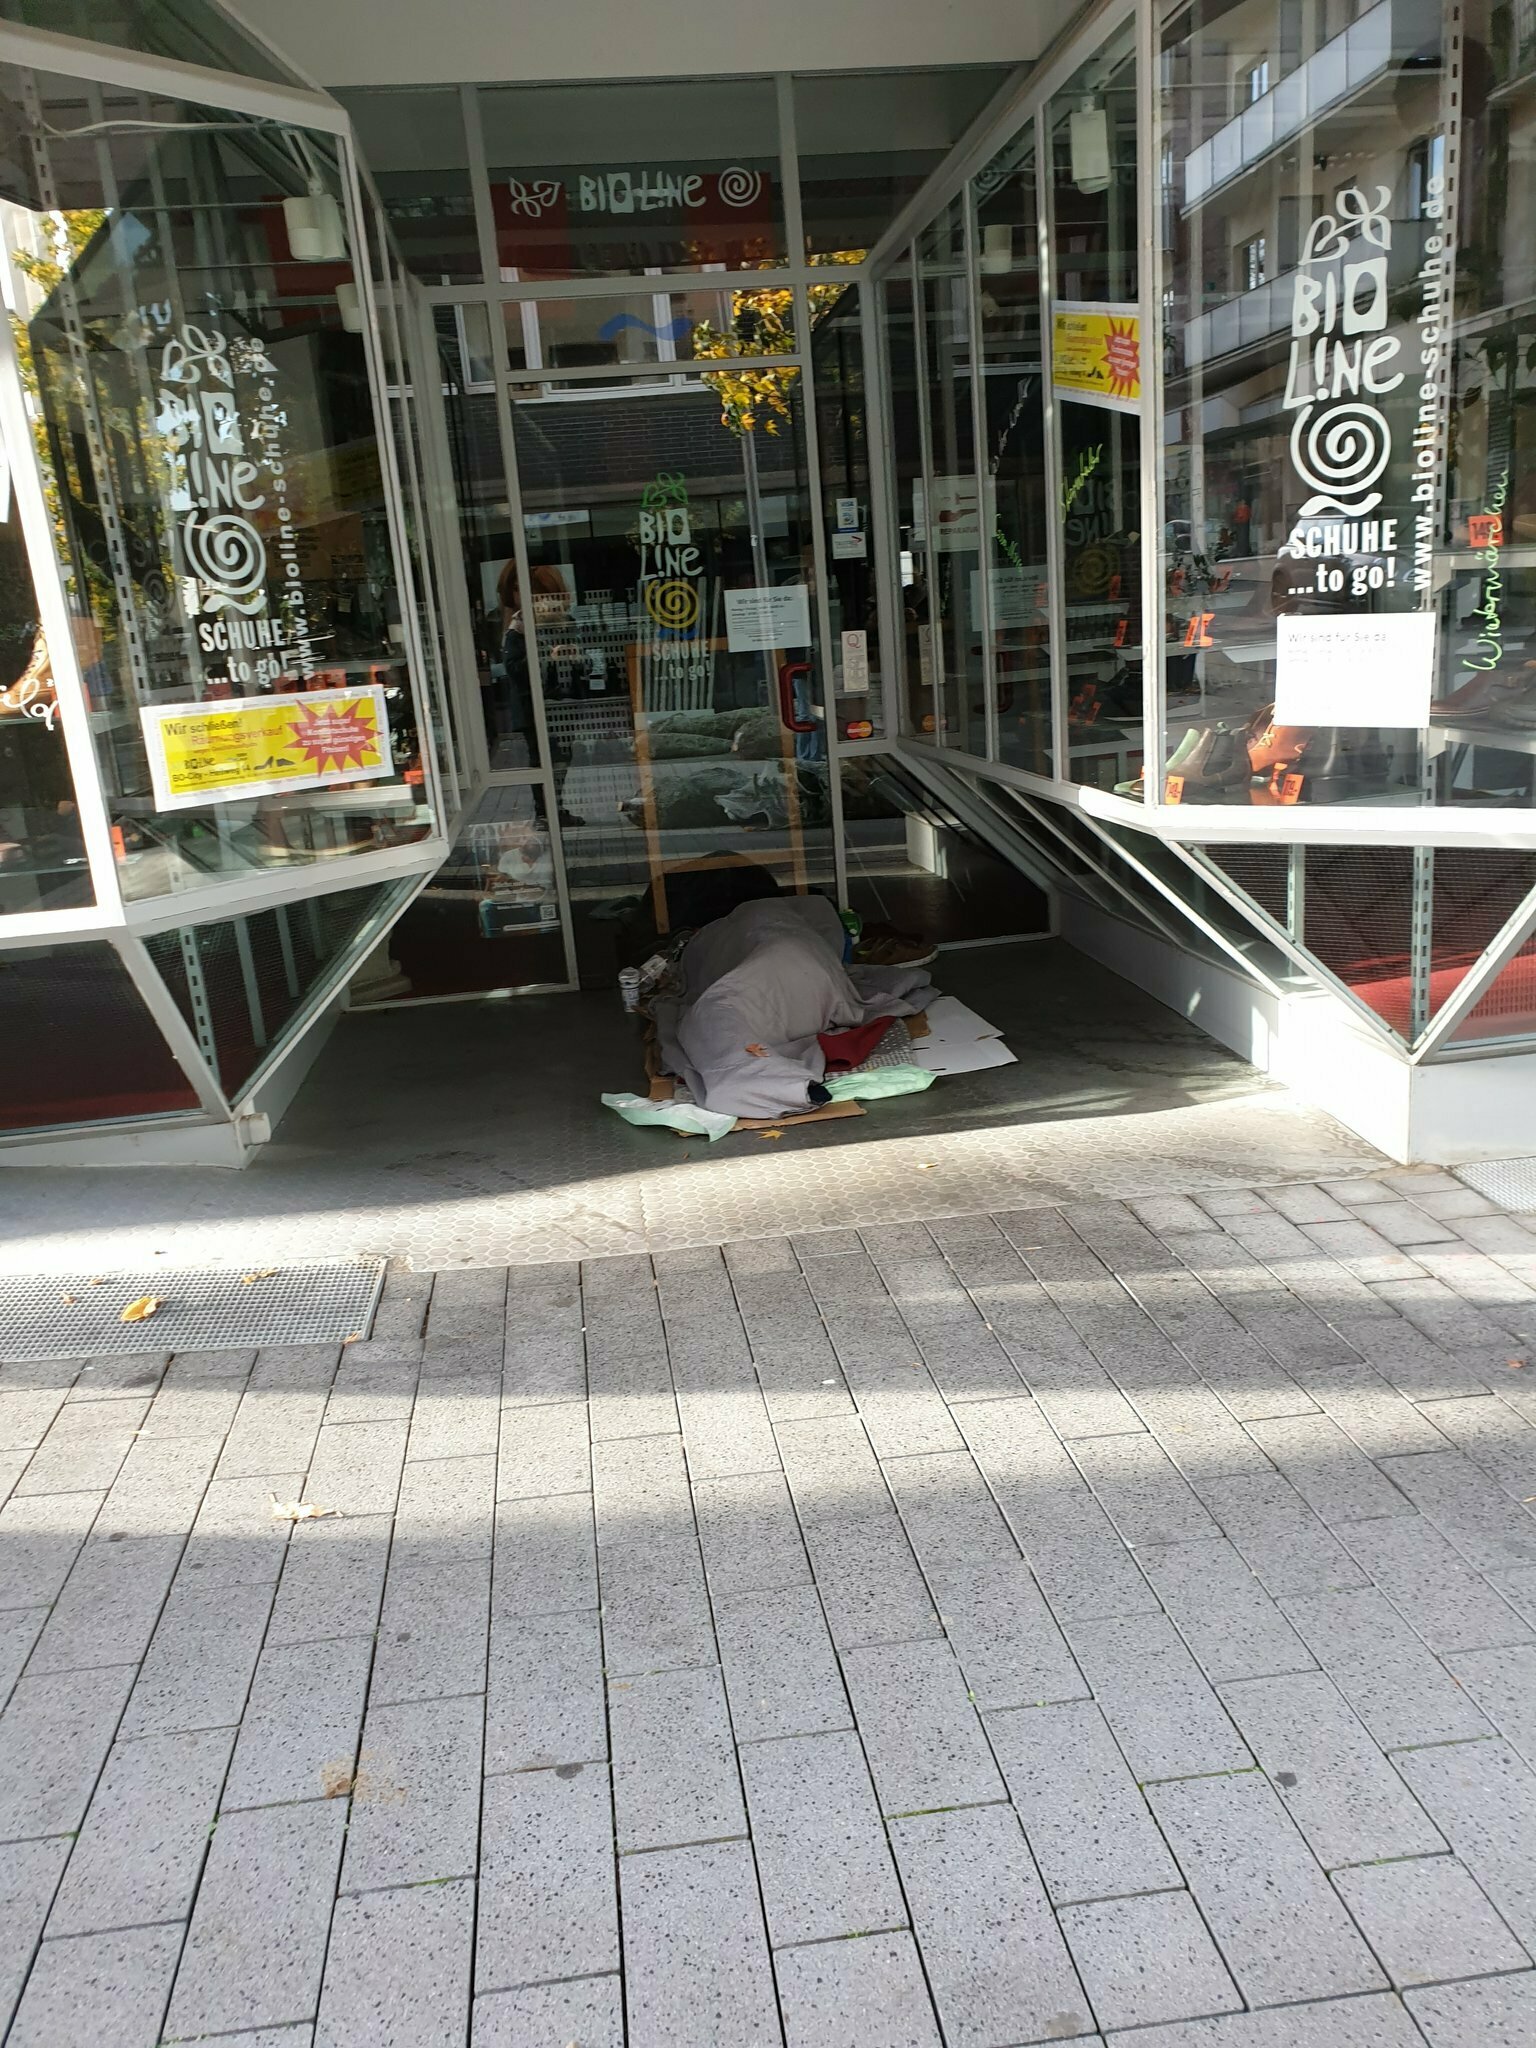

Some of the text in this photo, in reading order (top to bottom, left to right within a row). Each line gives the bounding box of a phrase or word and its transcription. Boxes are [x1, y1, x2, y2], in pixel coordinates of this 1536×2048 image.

[1292, 256, 1389, 337] BIO
[1411, 176, 1446, 593] www.bioline-schuhe.de
[639, 508, 691, 545] BIO
[1289, 518, 1398, 559] SCHUHE
[1351, 557, 1396, 596] go!
[199, 618, 286, 652] SCHUHE
[652, 640, 712, 662] SCHUHE
